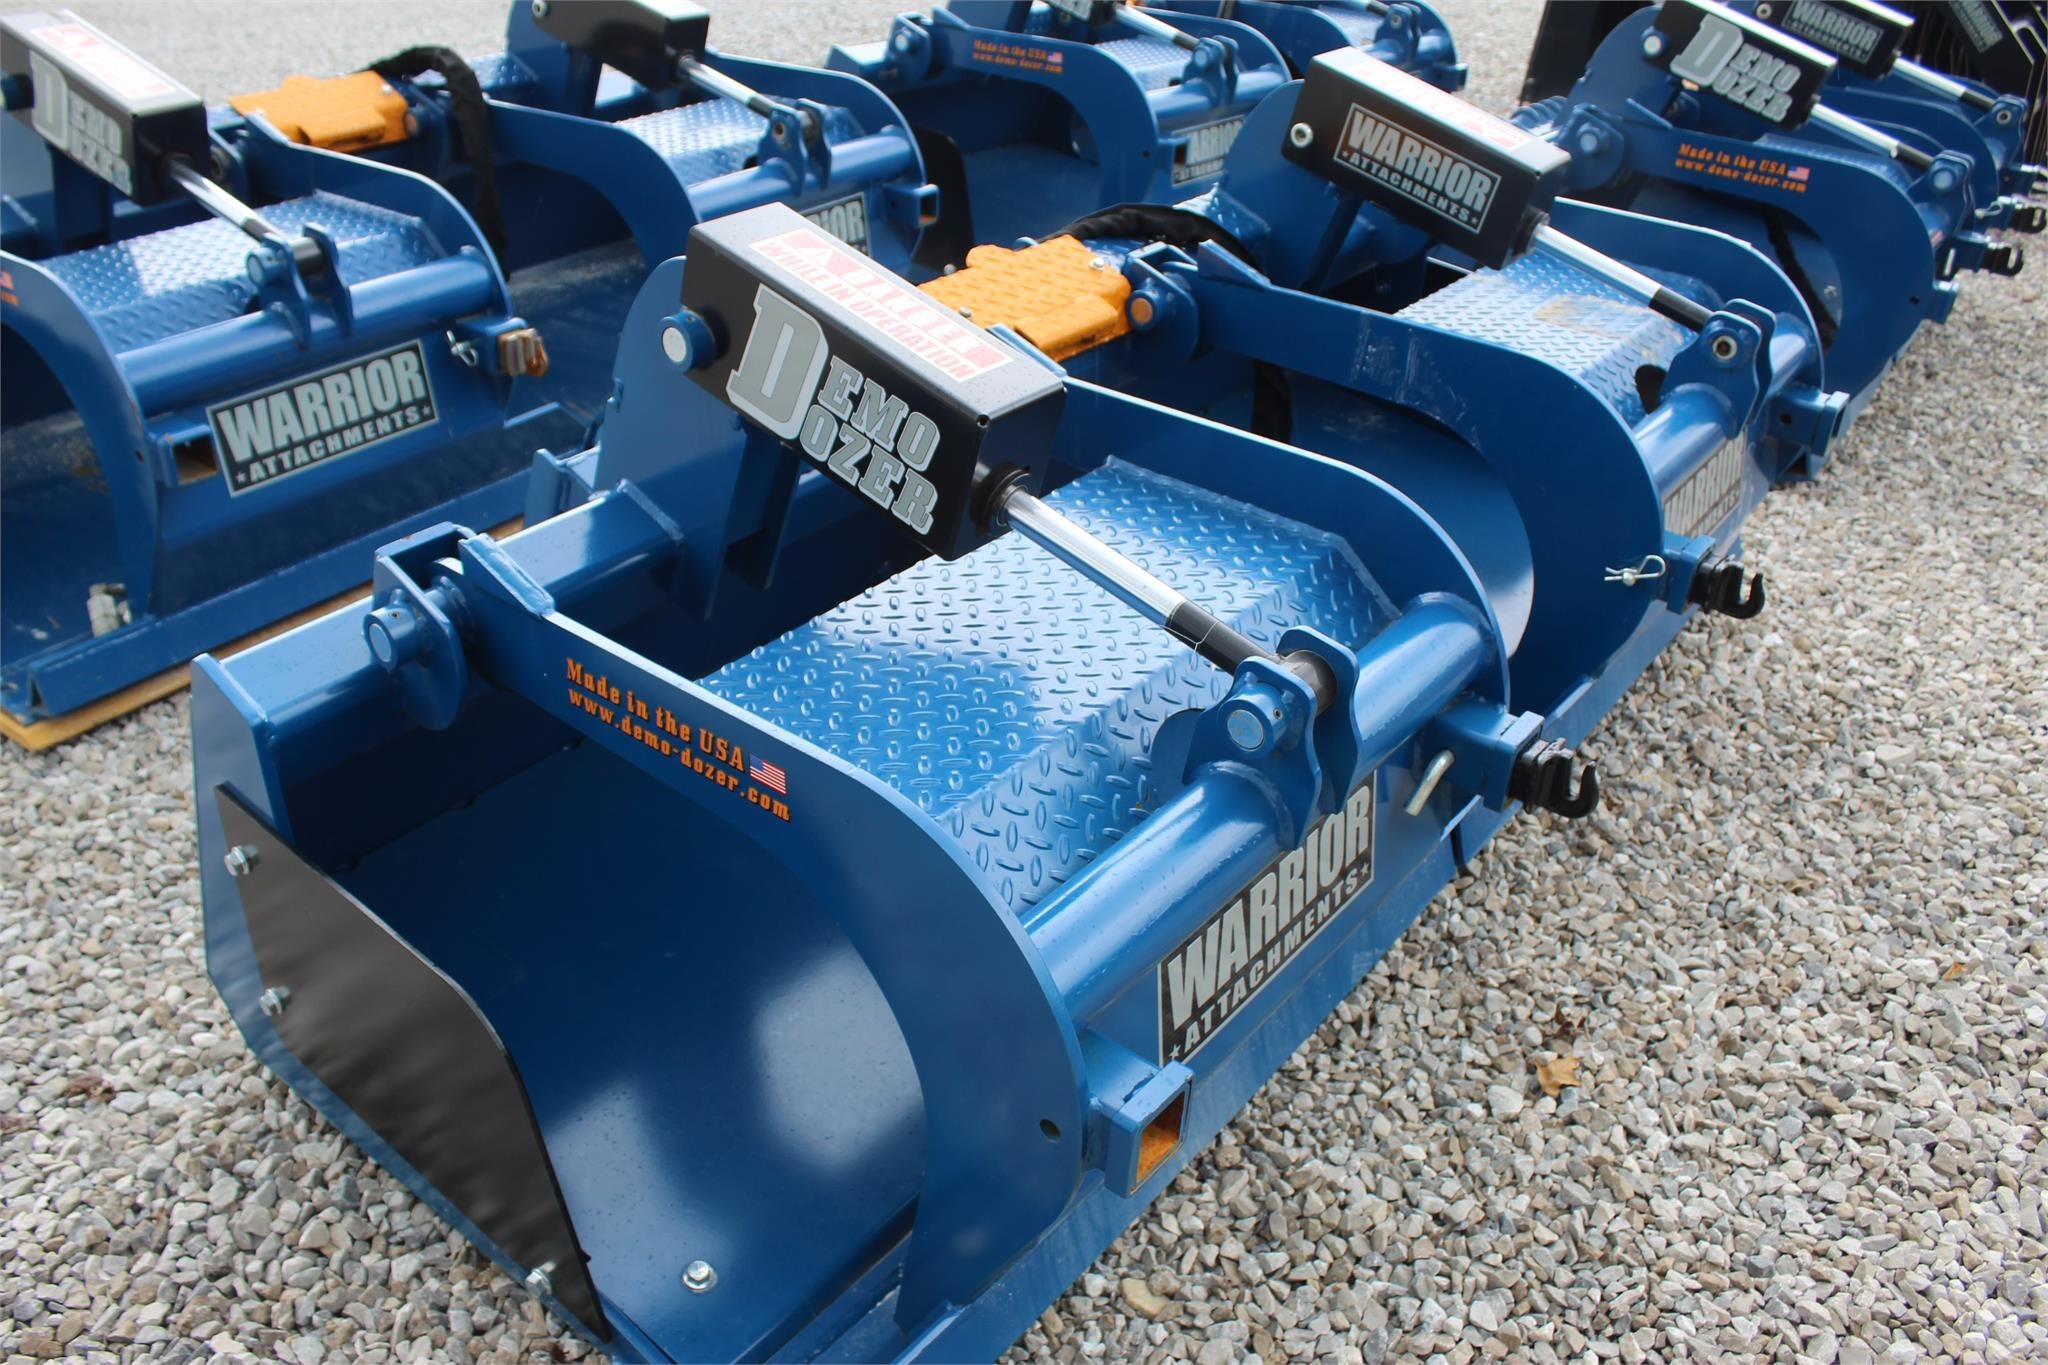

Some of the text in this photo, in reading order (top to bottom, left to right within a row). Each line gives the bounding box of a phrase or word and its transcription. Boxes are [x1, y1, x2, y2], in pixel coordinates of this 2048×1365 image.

[1670, 13, 1801, 93] DEMO
[1791, 0, 1878, 50] WARRIOR
[1347, 110, 1493, 212] WARRIOR
[1349, 151, 1471, 222] ATTACHMENTS
[1679, 143, 1714, 160] Made
[1733, 154, 1756, 169] the
[1759, 159, 1787, 176] USA
[758, 241, 977, 380] WHILE IN OPERATION
[216, 350, 426, 463] WARRIOR
[726, 283, 941, 472] DEMO
[249, 405, 421, 483] ATTACHMENTS
[566, 658, 746, 773] Made in the USA
[568, 688, 792, 822] www.demo-dozer.com
[1167, 785, 1370, 1031] WARRIOR
[1184, 868, 1358, 1054] ATTACHMENTS
